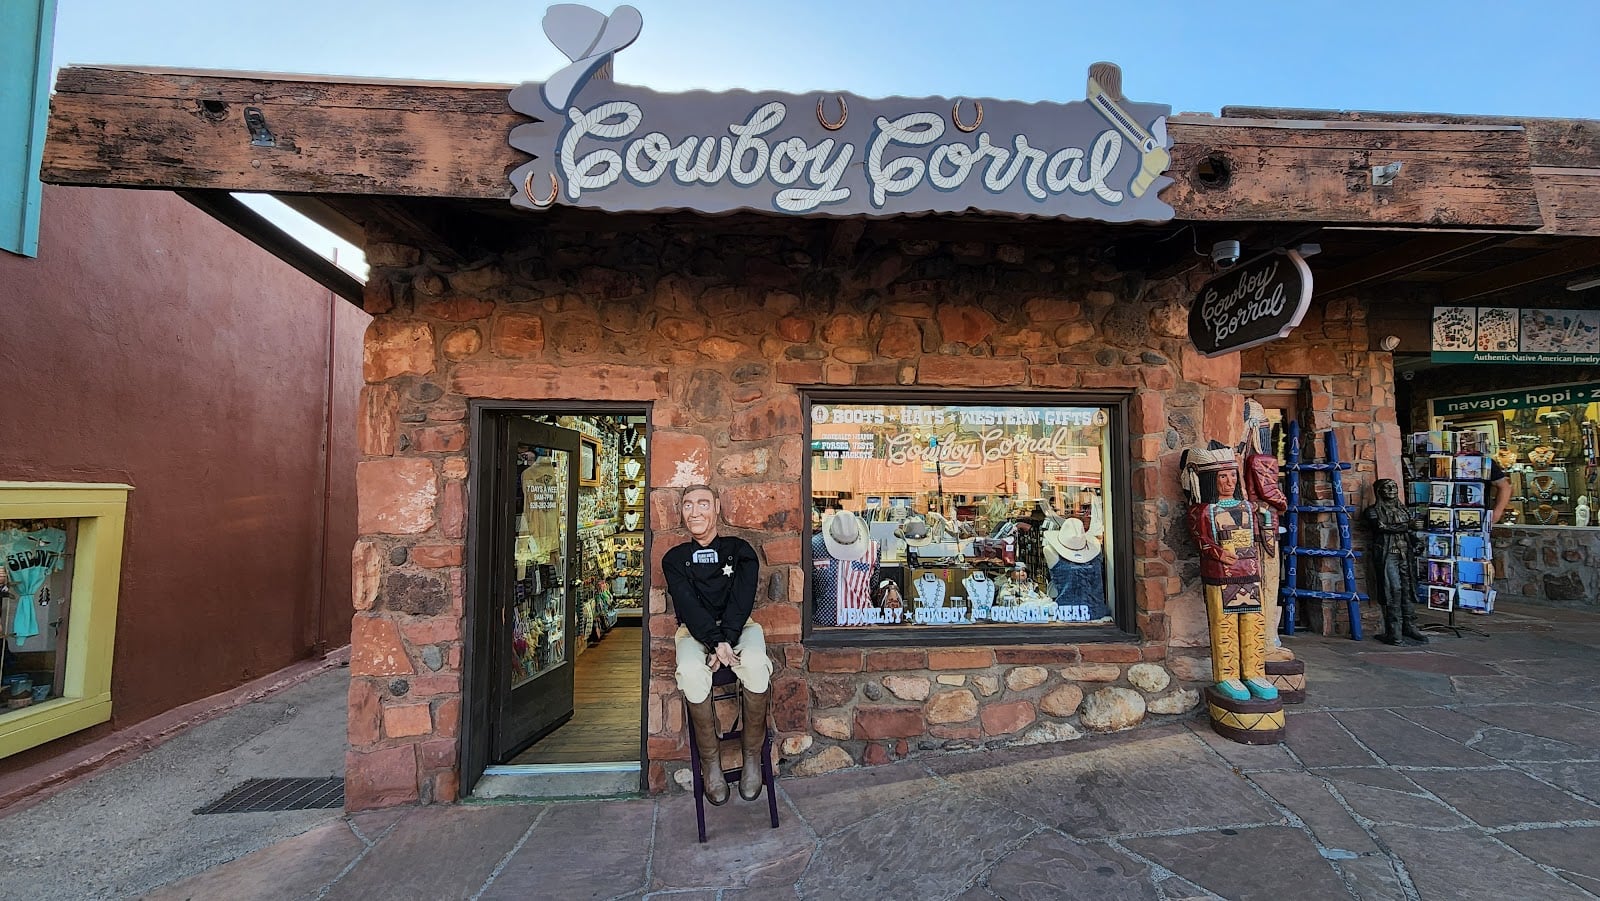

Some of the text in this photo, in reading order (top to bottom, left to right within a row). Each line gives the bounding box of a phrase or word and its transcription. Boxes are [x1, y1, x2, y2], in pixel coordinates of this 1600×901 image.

[559, 101, 1123, 211] Cowboy Corral
[1201, 260, 1279, 331] Cowboy
[1213, 282, 1287, 347] Corral
[1473, 353, 1511, 361] Authentic
[1537, 354, 1573, 362] American
[1573, 355, 1600, 364] Jewelry
[1448, 397, 1508, 411] navajo
[1525, 389, 1571, 404] hopi
[832, 408, 1092, 426] BOOTS HATS WESTERN GIFTS
[885, 431, 983, 477] Cowboy
[977, 427, 1071, 467] Corral
[531, 485, 544, 494] DAYS
[837, 607, 903, 625] JEWELRY
[915, 607, 968, 624] COWBOY
[991, 605, 1049, 622] COWGIRL
[1053, 605, 1091, 621] WEAR
